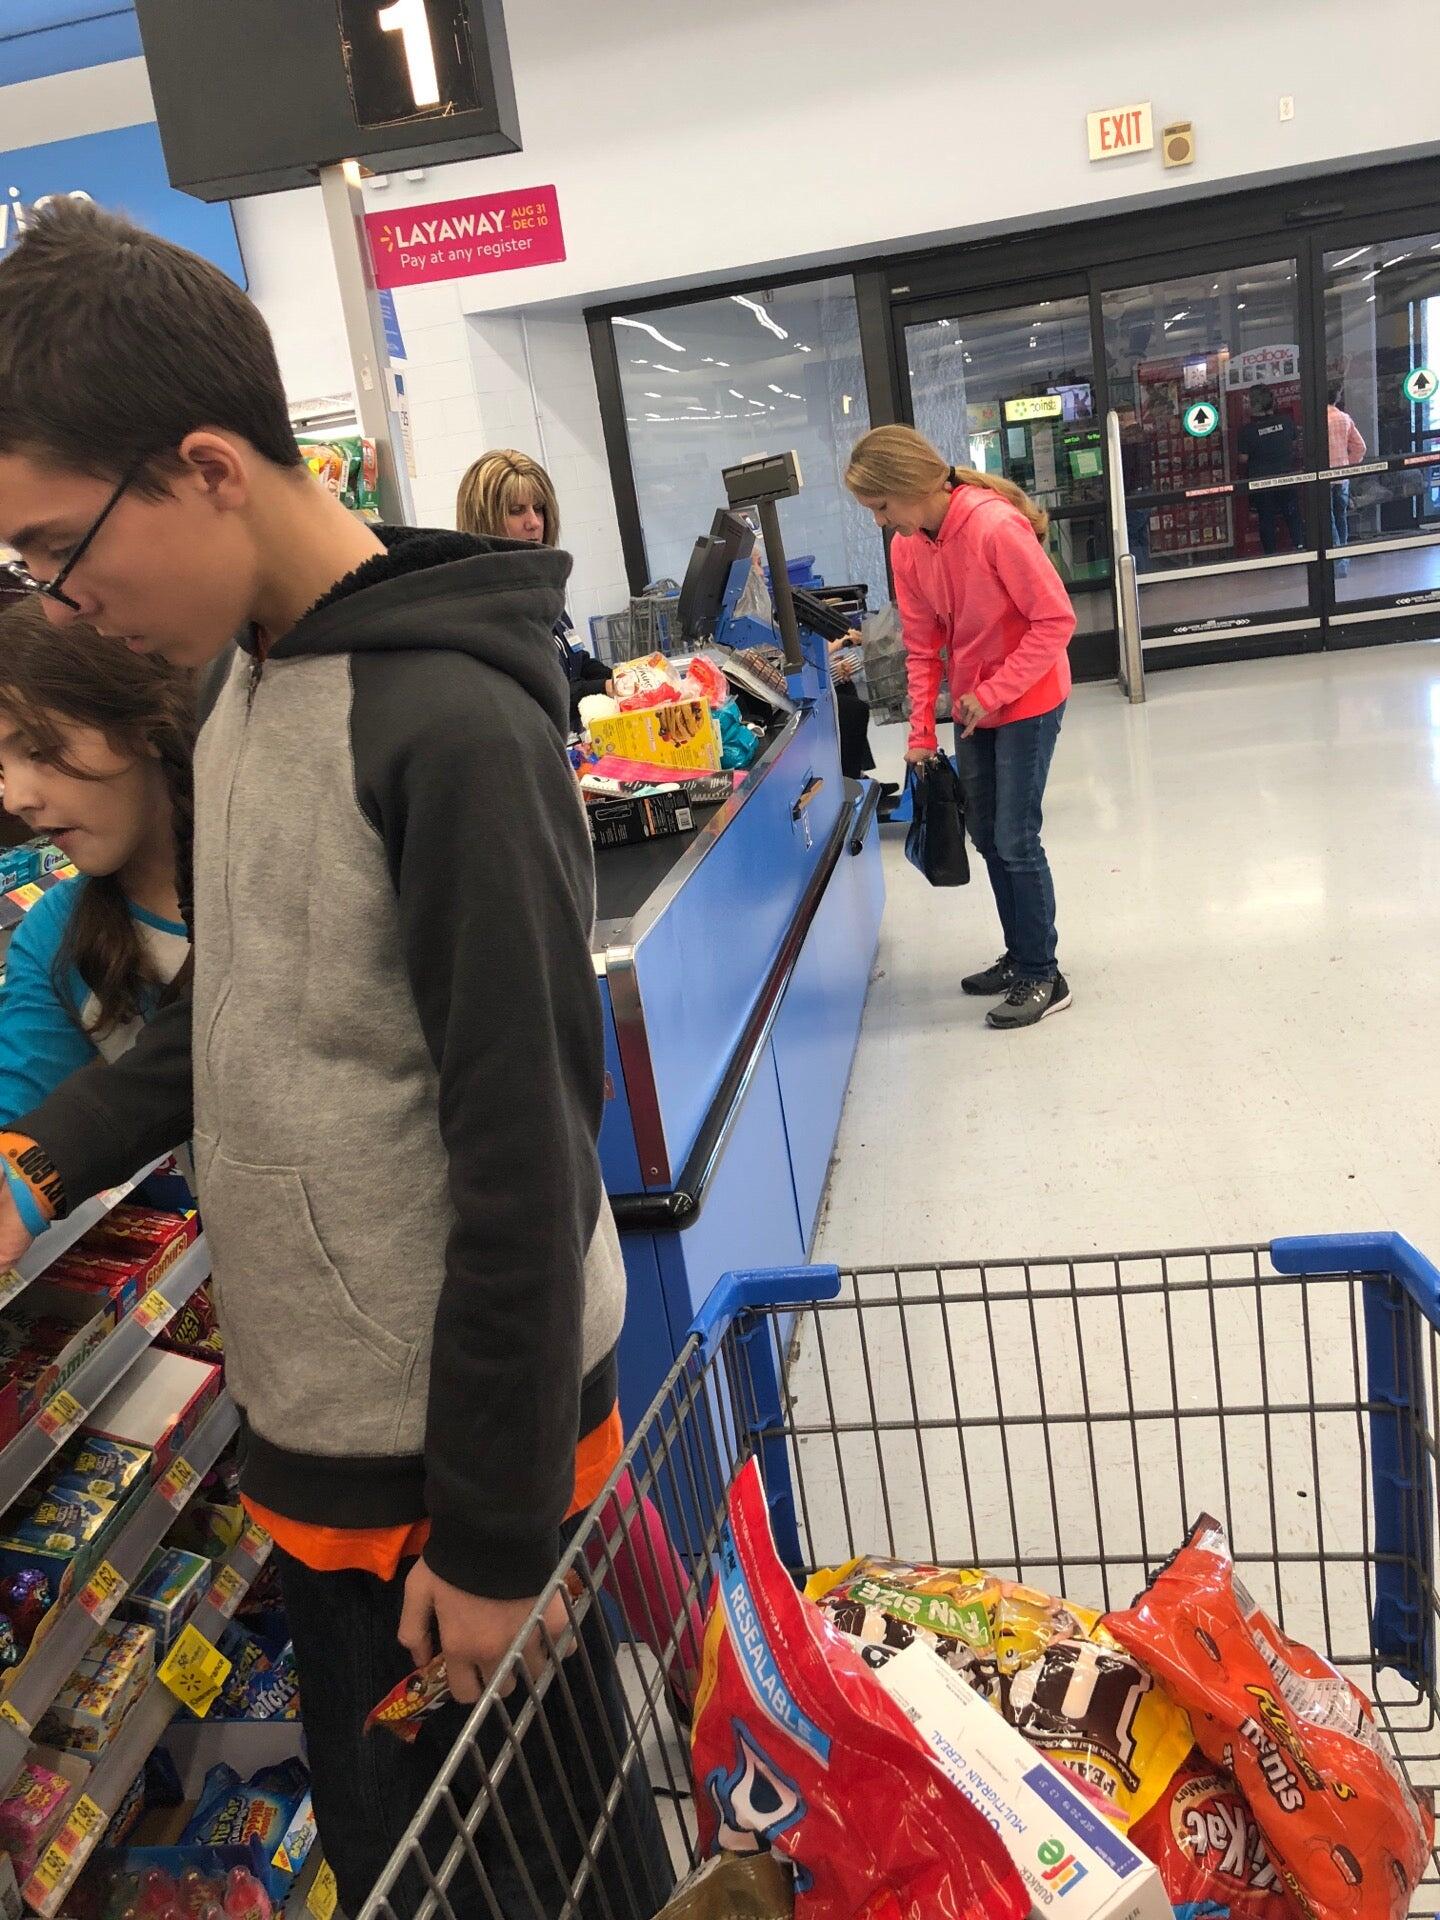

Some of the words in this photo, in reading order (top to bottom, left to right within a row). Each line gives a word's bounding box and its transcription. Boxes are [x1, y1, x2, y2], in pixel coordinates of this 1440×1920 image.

[377, 0, 440, 107] 1
[1099, 110, 1142, 151] EXIT
[395, 209, 506, 249] LAYAWAY
[511, 205, 534, 219] AUG
[536, 203, 546, 214] 31
[512, 217, 535, 231] DEC
[536, 215, 548, 227] 10
[401, 254, 427, 270] Pay
[430, 250, 445, 264] at
[448, 248, 473, 263] any
[477, 237, 533, 258] register
[858, 1581, 922, 1614] SIZE
[928, 1599, 981, 1640] FUN
[730, 1582, 813, 1741] RESEALABLE
[931, 1729, 967, 1768] CEREAL
[967, 1764, 1027, 1834] MULTIGRAIN
[1186, 1801, 1248, 1877] Kat
[1019, 1869, 1054, 1906] QUAKER
[1037, 1838, 1089, 1898] Life
